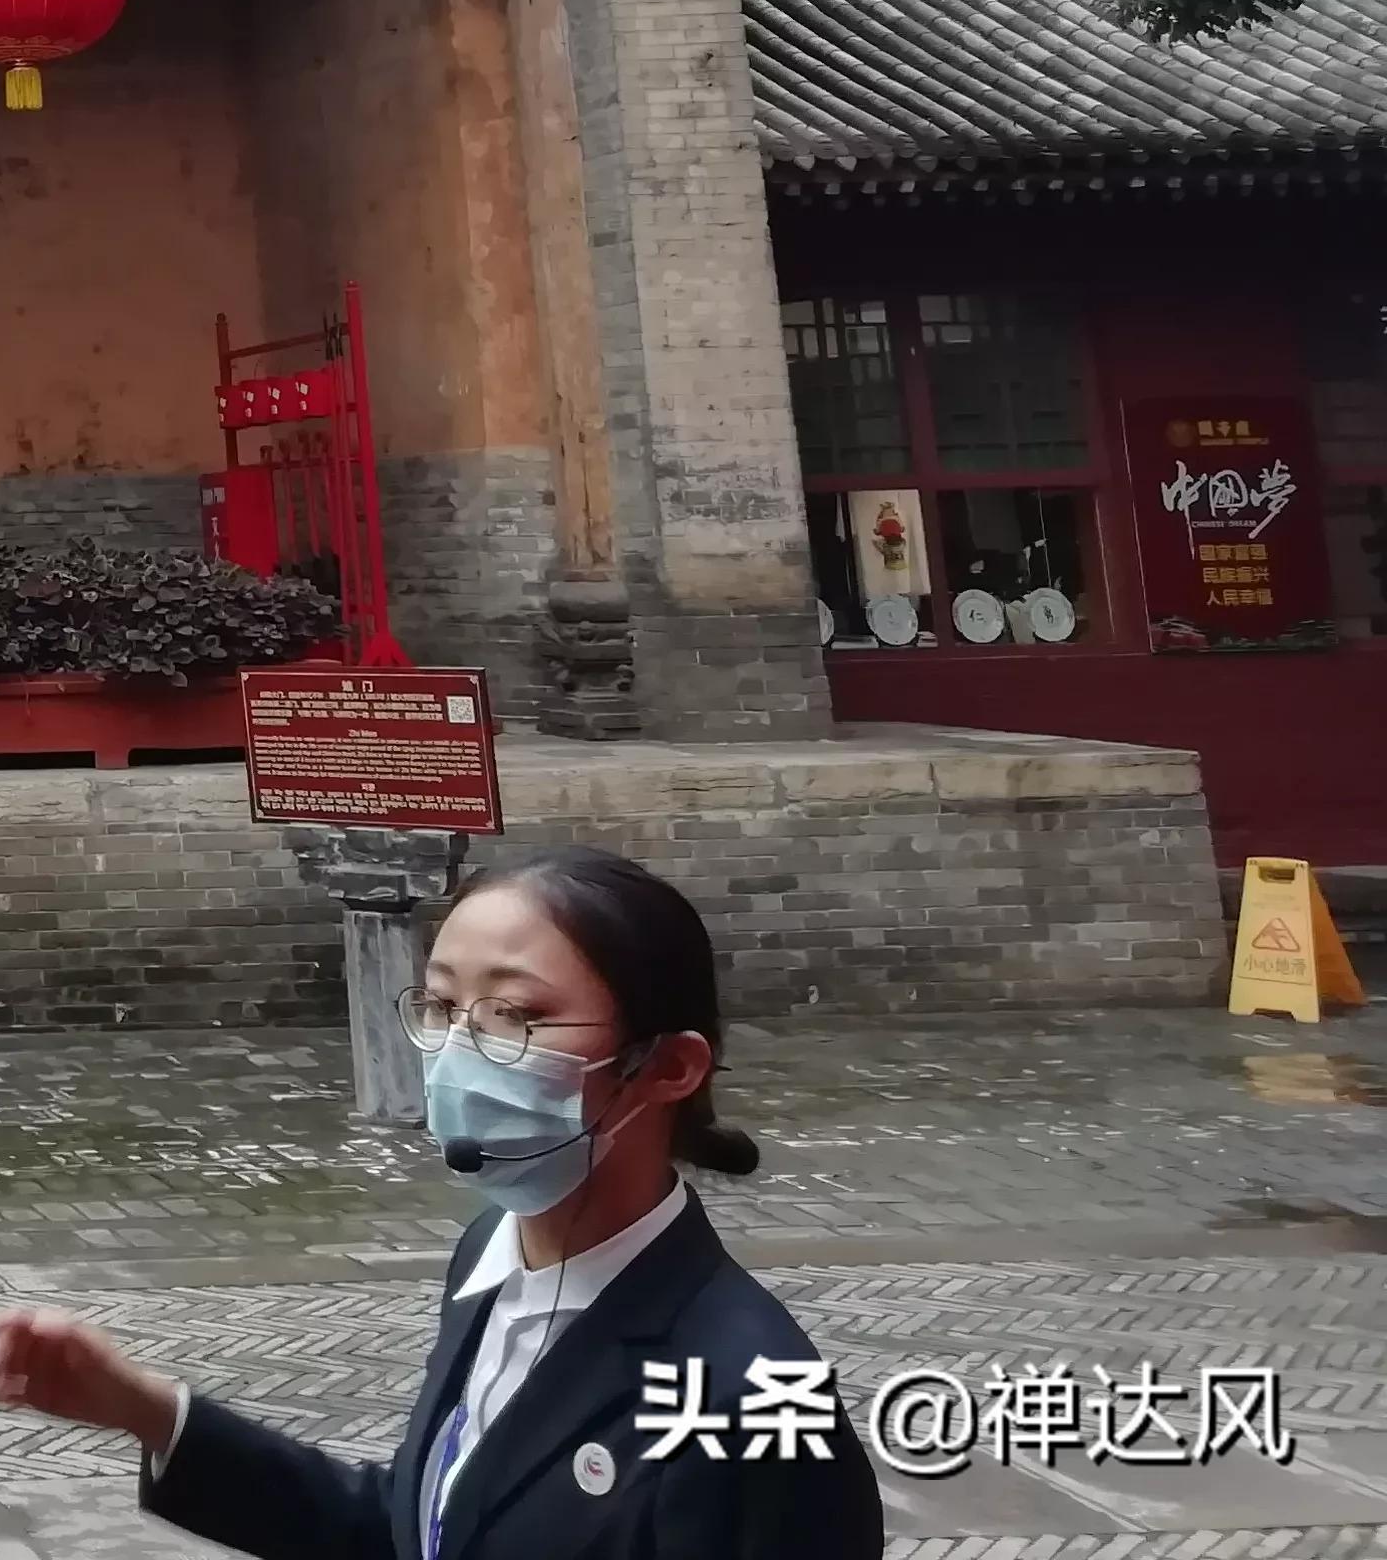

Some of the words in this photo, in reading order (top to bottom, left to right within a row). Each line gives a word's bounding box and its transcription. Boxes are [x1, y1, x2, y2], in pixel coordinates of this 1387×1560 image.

[1198, 543, 1269, 561] 国家富强
[1202, 565, 1270, 584] 民族振兴
[1206, 587, 1274, 606] 人民幸福
[1243, 953, 1308, 977] 小心地滑
